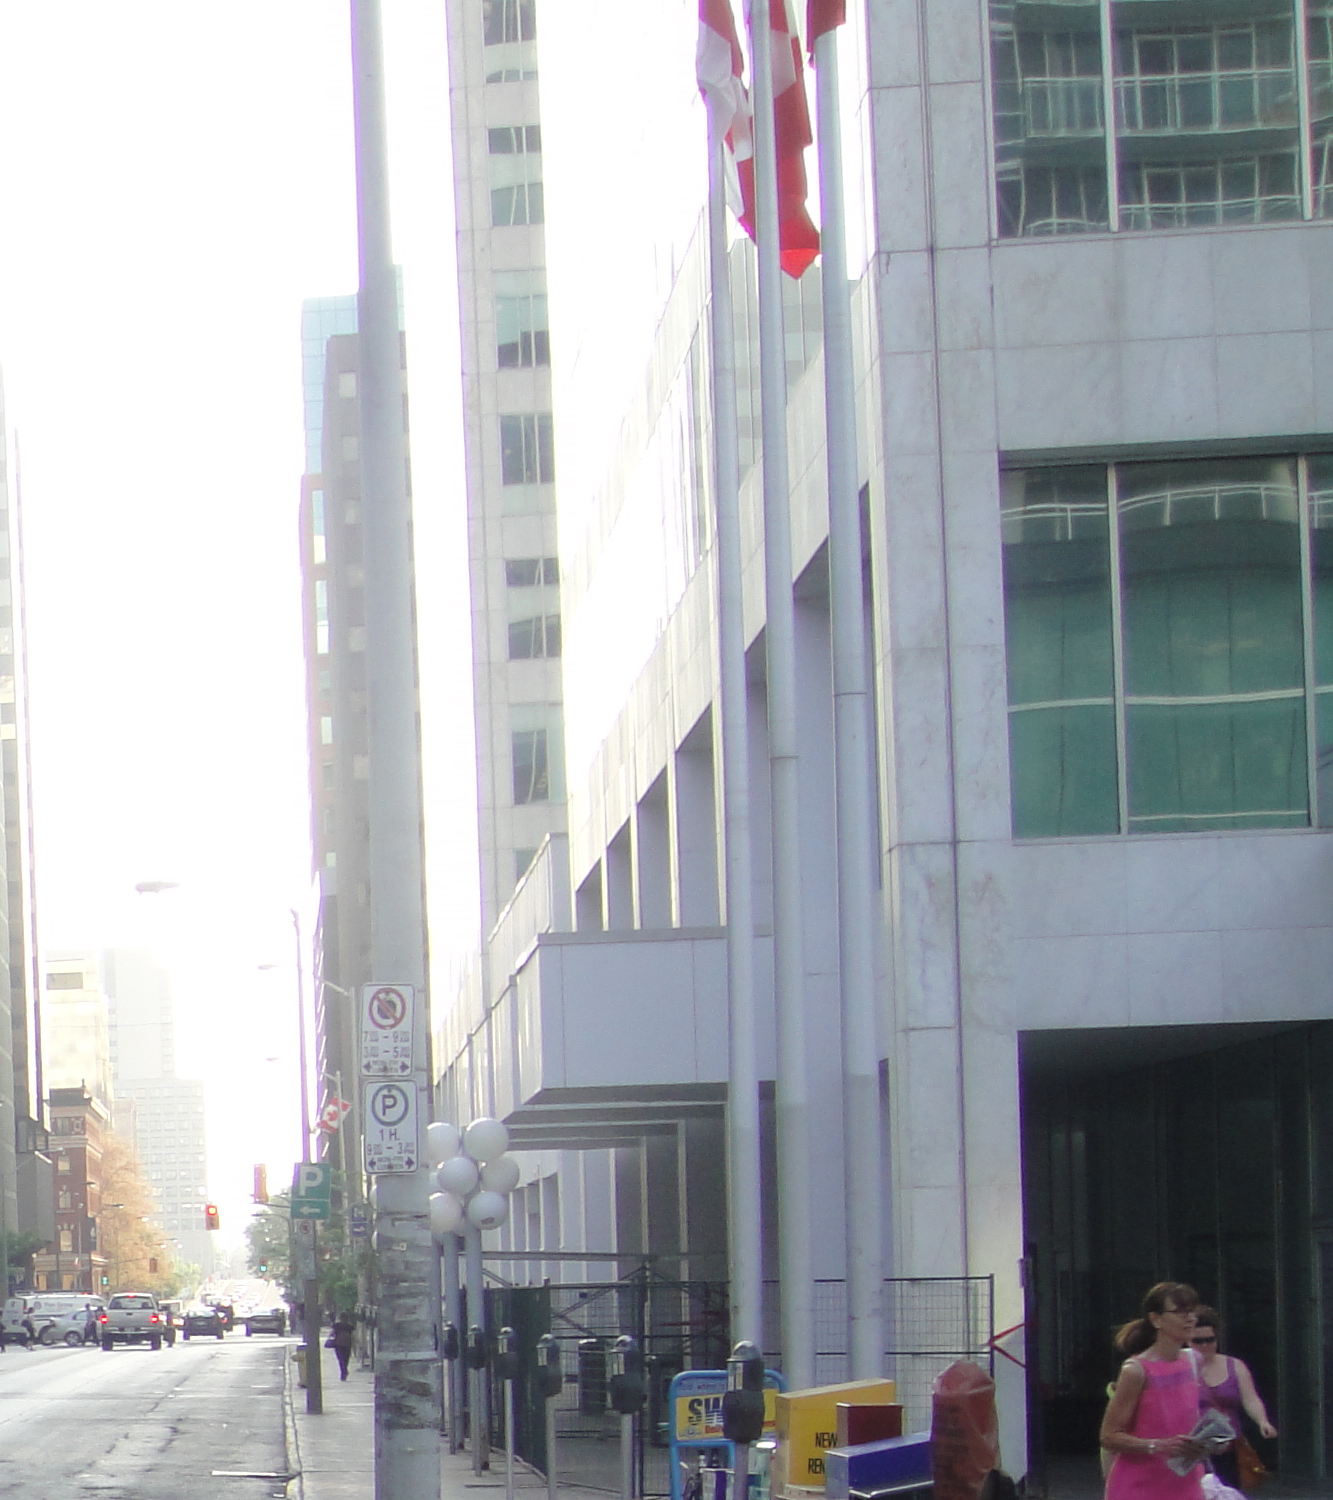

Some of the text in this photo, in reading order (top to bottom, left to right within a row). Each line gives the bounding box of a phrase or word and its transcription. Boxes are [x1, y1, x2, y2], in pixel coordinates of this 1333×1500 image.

[382, 1094, 397, 1116] P
[379, 1128, 384, 1141] 1
[299, 1165, 324, 1197] P
